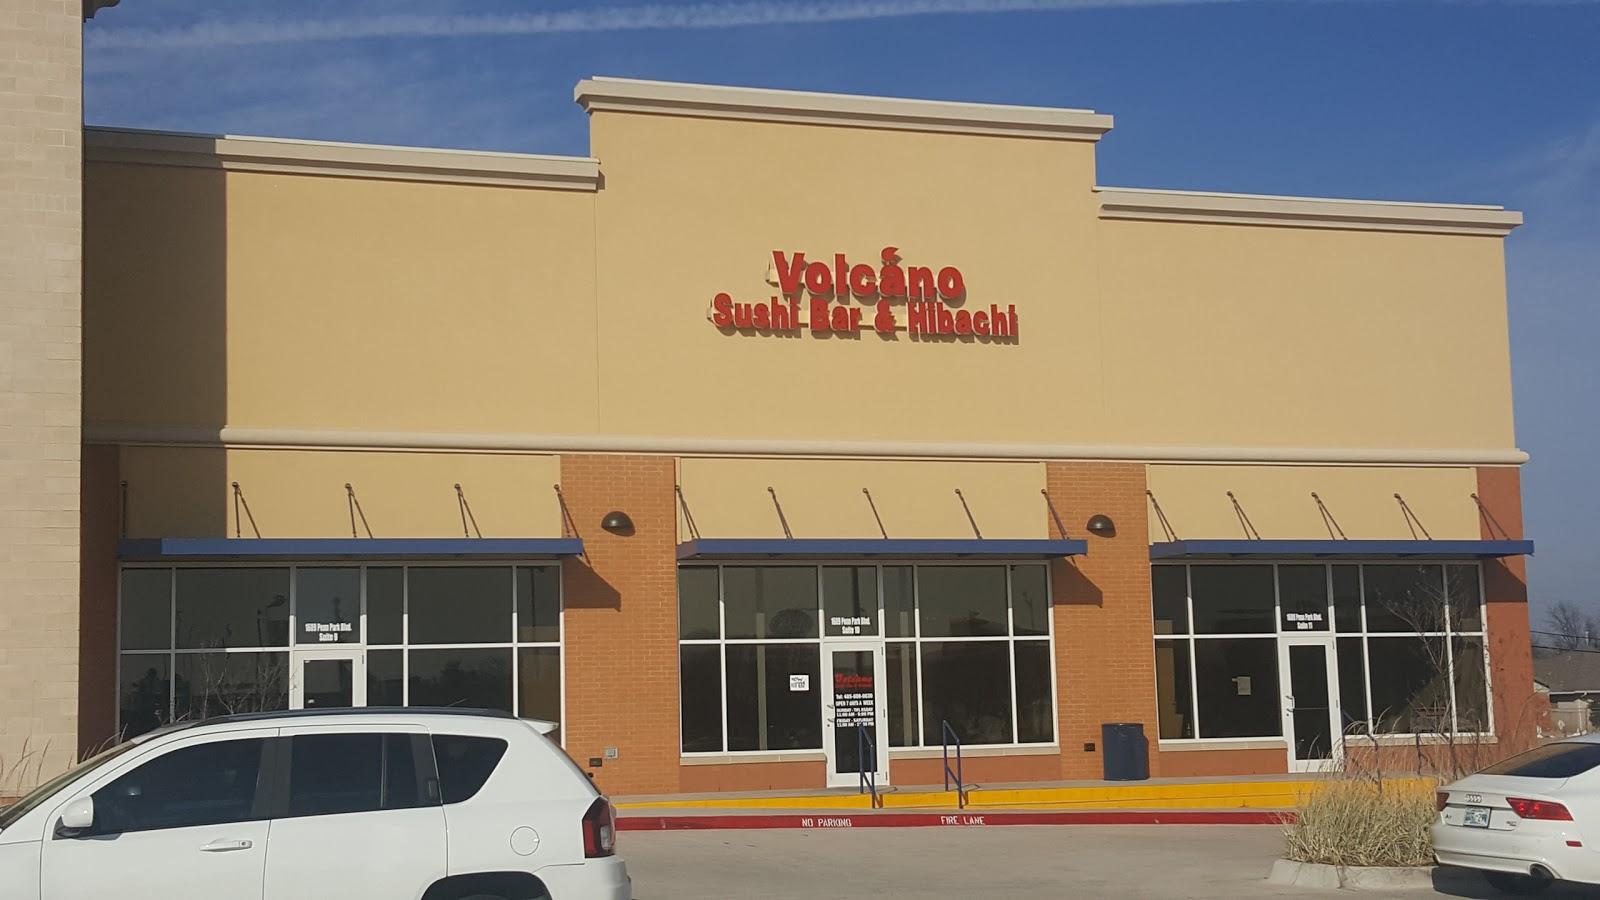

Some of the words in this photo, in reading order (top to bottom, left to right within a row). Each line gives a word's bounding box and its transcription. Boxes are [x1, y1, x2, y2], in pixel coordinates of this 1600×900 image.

[772, 247, 966, 298] Volcano
[713, 292, 800, 330] Sushi
[810, 298, 861, 332] Bar
[874, 299, 896, 333] &
[907, 300, 1017, 336] Hibachi
[802, 818, 814, 827] NO
[818, 818, 852, 827] PARKING
[940, 816, 958, 825] FIRE
[964, 816, 986, 825] LANE
